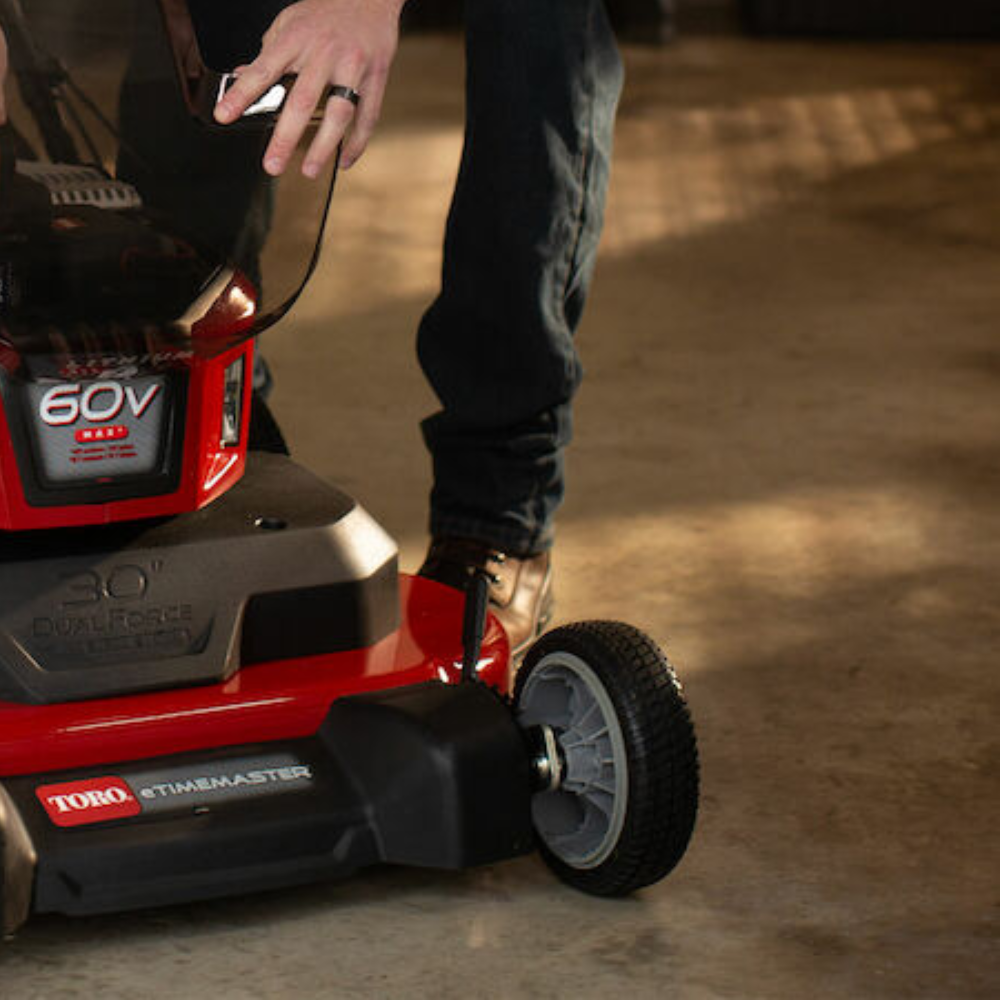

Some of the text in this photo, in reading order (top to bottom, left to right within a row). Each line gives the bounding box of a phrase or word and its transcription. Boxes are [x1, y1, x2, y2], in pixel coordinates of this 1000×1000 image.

[39, 381, 160, 426] 60V
[48, 764, 313, 813] TORO eTIMEMASTER
